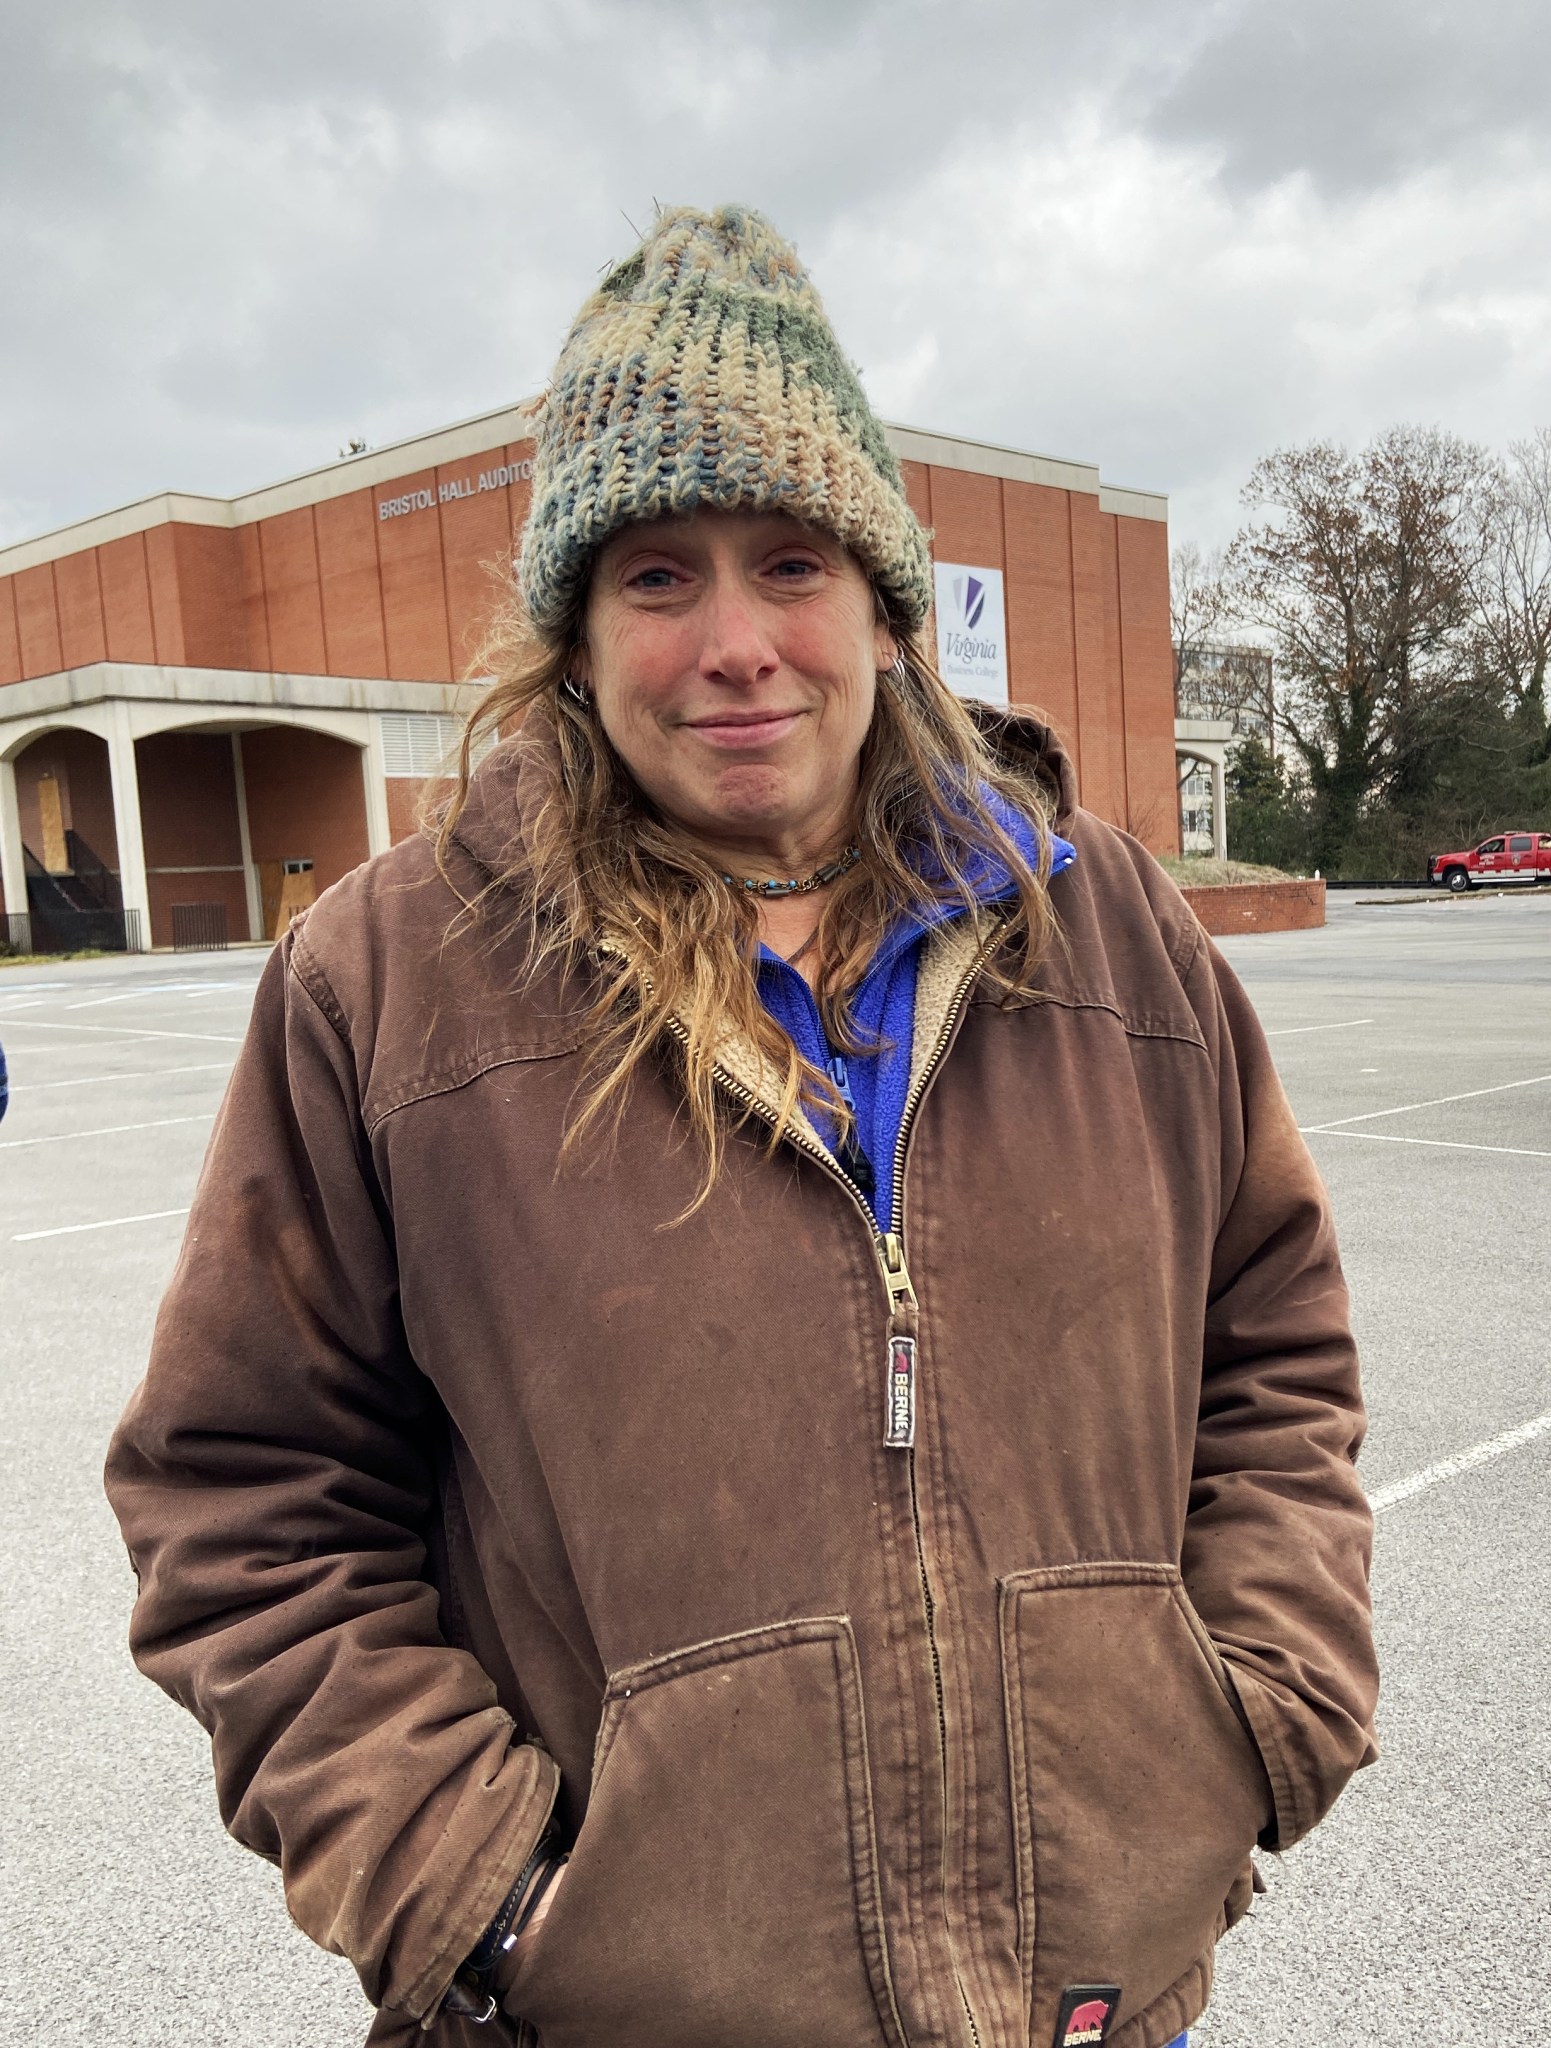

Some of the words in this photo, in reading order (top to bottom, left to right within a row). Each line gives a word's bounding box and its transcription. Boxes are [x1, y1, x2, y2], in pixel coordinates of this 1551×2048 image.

[379, 489, 436, 520] BRISTOL
[438, 478, 475, 503] HALL
[946, 632, 997, 664] Virginia
[895, 1373, 909, 1431] BERNE
[1063, 2029, 1102, 2047] BERNE
